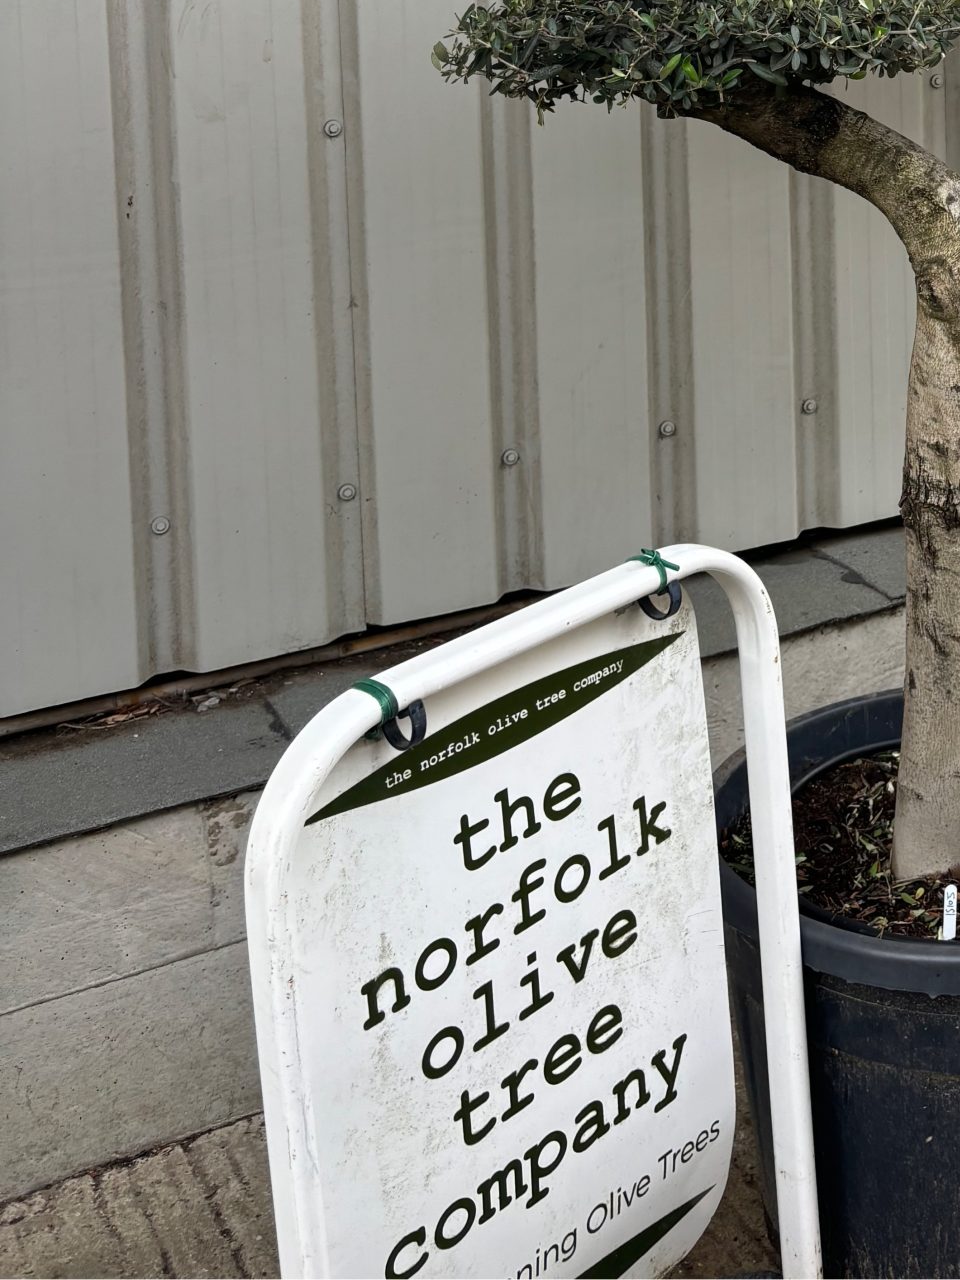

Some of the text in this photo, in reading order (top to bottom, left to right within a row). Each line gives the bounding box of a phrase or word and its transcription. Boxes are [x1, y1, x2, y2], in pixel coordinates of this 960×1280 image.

[385, 658, 625, 789] the norfolk olive tree company
[453, 772, 581, 871] the
[361, 795, 671, 1031] norfolk
[421, 909, 638, 1080] olive
[453, 1004, 624, 1146] tree
[384, 1033, 688, 1280] company
[586, 1174, 651, 1234] Olive
[658, 1119, 722, 1180] Trees
